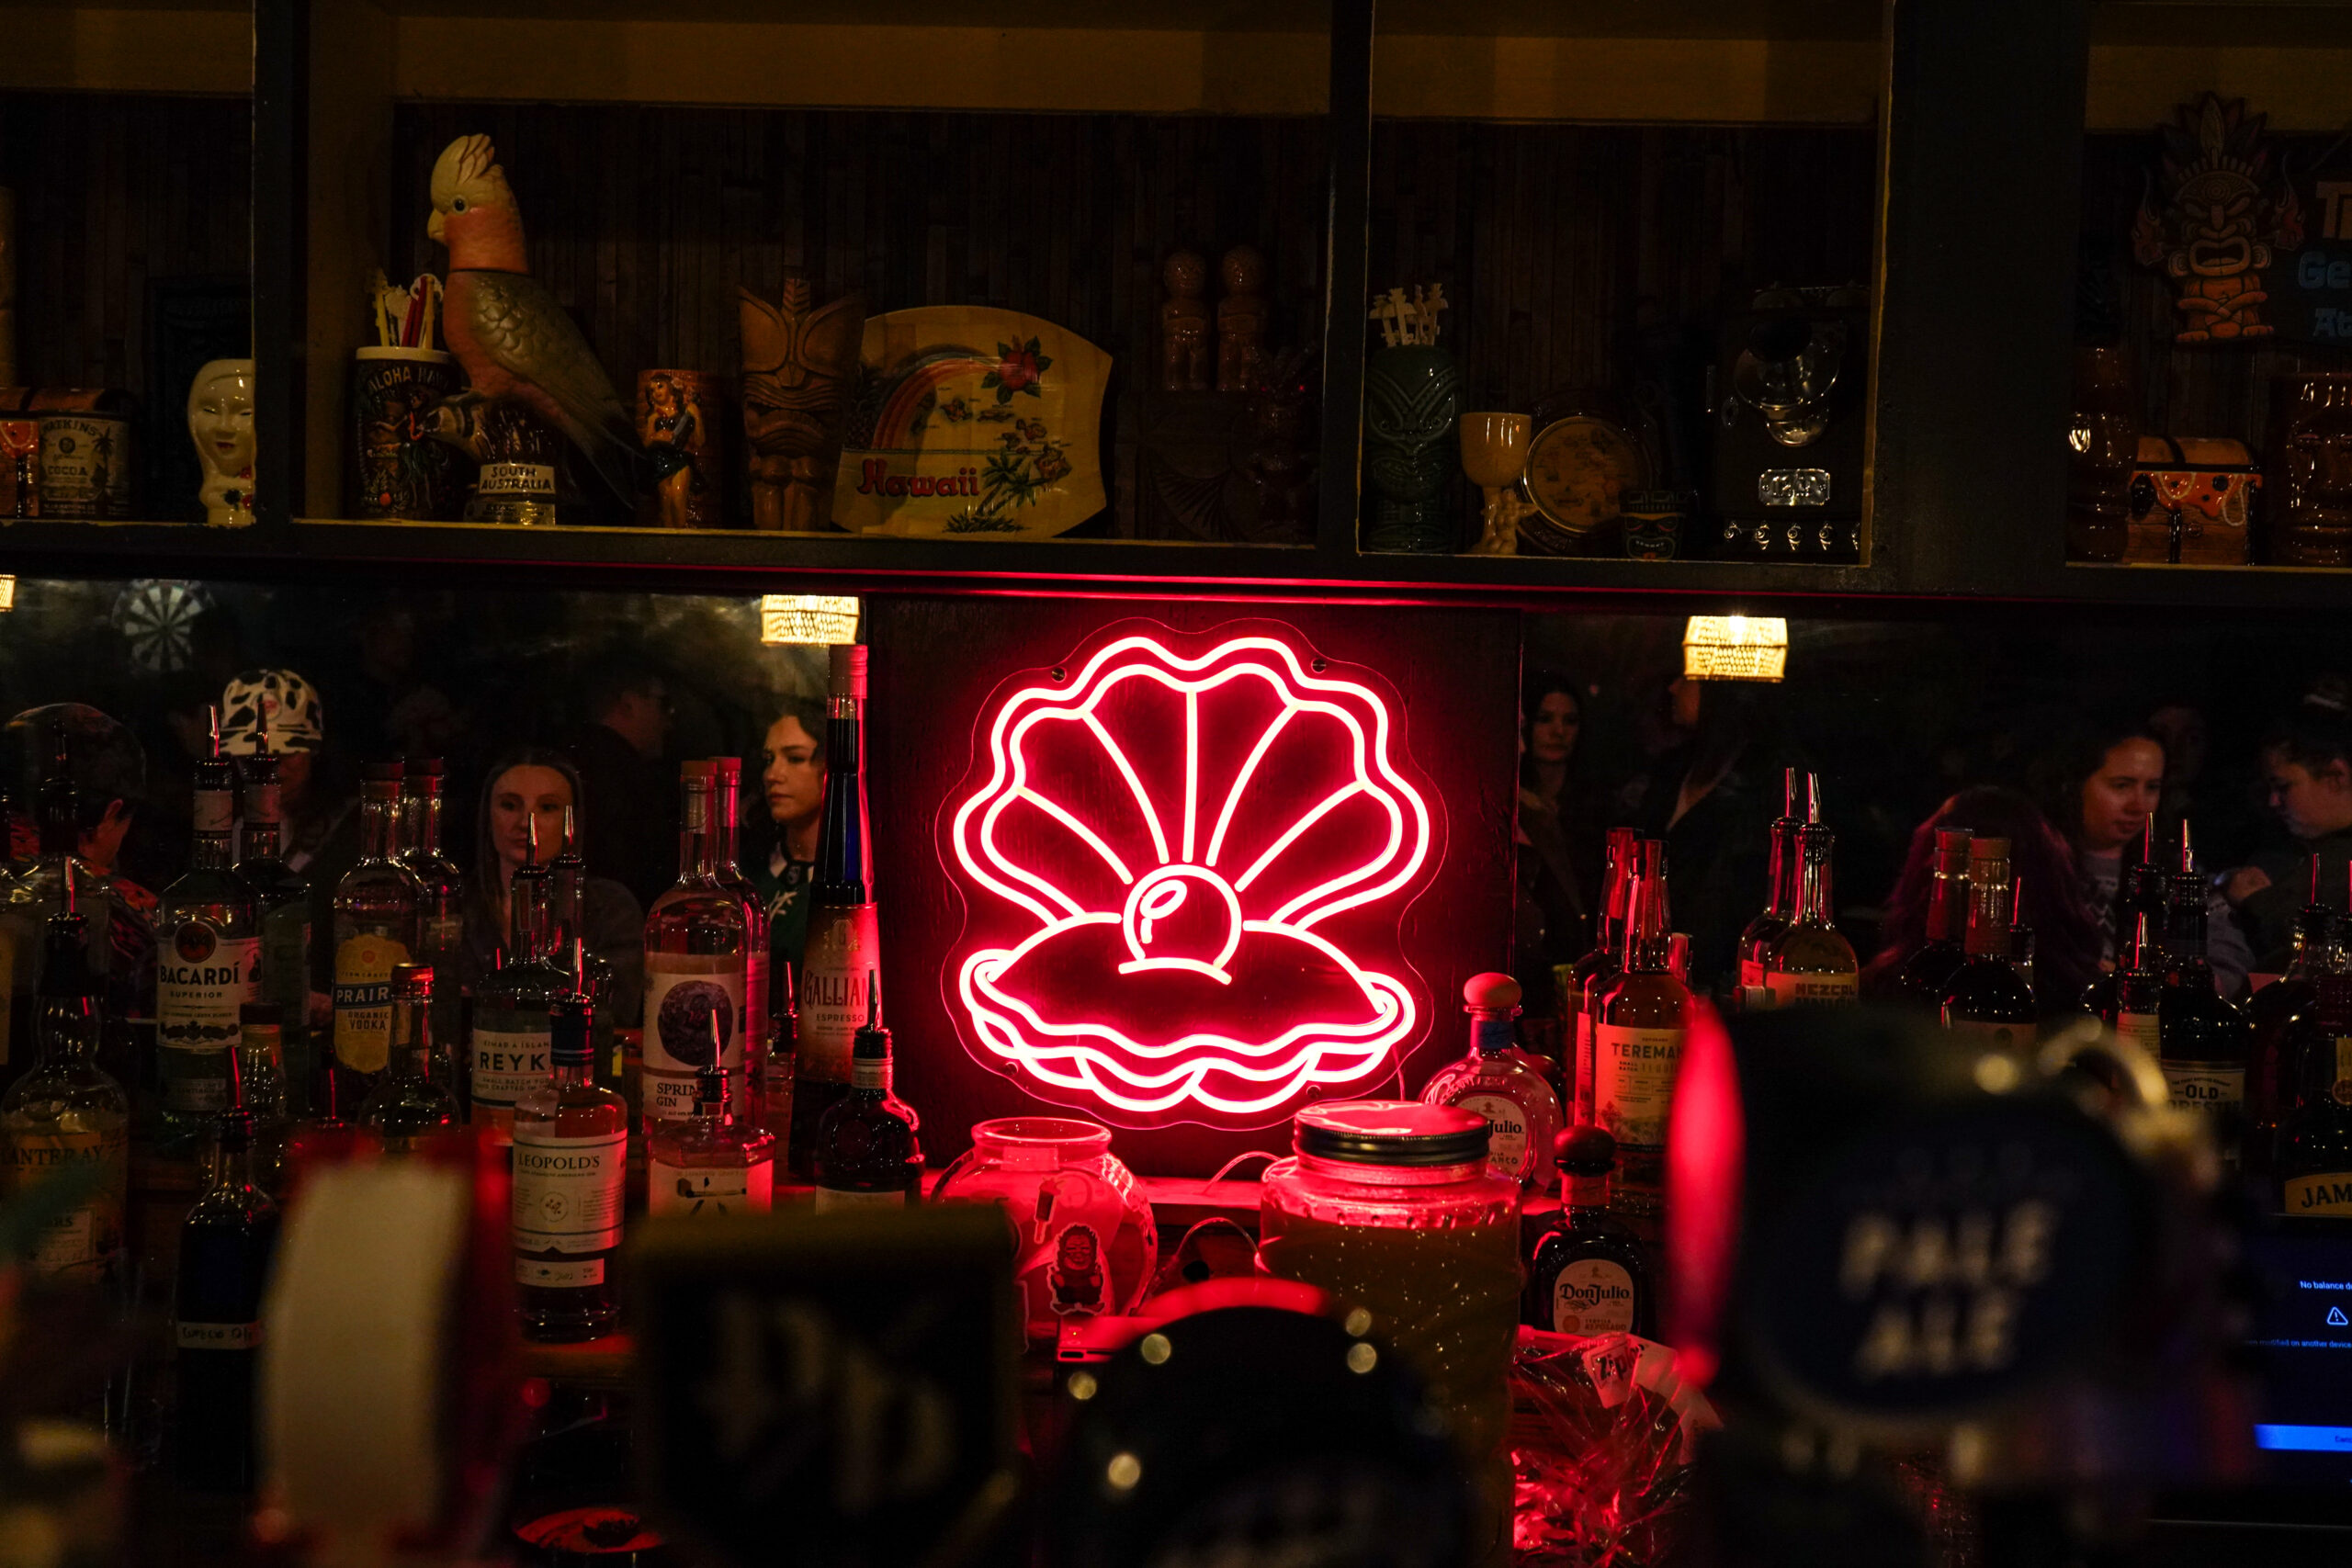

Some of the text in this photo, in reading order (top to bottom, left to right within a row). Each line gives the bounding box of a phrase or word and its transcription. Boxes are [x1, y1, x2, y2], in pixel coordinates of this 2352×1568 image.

[2316, 181, 2352, 241] TI
[2298, 251, 2352, 288] Ge
[2312, 308, 2352, 337] At
[368, 367, 413, 391] ALOHA
[48, 466, 88, 476] COCOA
[491, 467, 537, 478] SOUTH
[856, 458, 980, 497] Hawaii
[481, 479, 552, 491] AUSTRALIA
[160, 962, 241, 986] BACARDÍ
[170, 990, 223, 998] SUPERIOR
[336, 987, 390, 1003] PRAIR
[804, 969, 869, 1009] GALLIAN
[347, 1011, 390, 1020] ORGANIC
[816, 1013, 865, 1022] ESPRESSO
[349, 1019, 387, 1031] VODKA
[1611, 1043, 1683, 1059] TEREMAN
[479, 1051, 546, 1072] REYK
[657, 1083, 697, 1096] SPRIN
[2186, 1084, 2219, 1100] OLD
[656, 1096, 677, 1107] GIN
[518, 1153, 600, 1169] LEOPOLD'S
[1490, 1156, 1519, 1165] ANCO
[2301, 1184, 2352, 1208] JAM
[2300, 1280, 2312, 1290] No
[2312, 1280, 2345, 1291] balance
[2301, 1339, 2327, 1348] another
[2329, 1340, 2352, 1349] device
